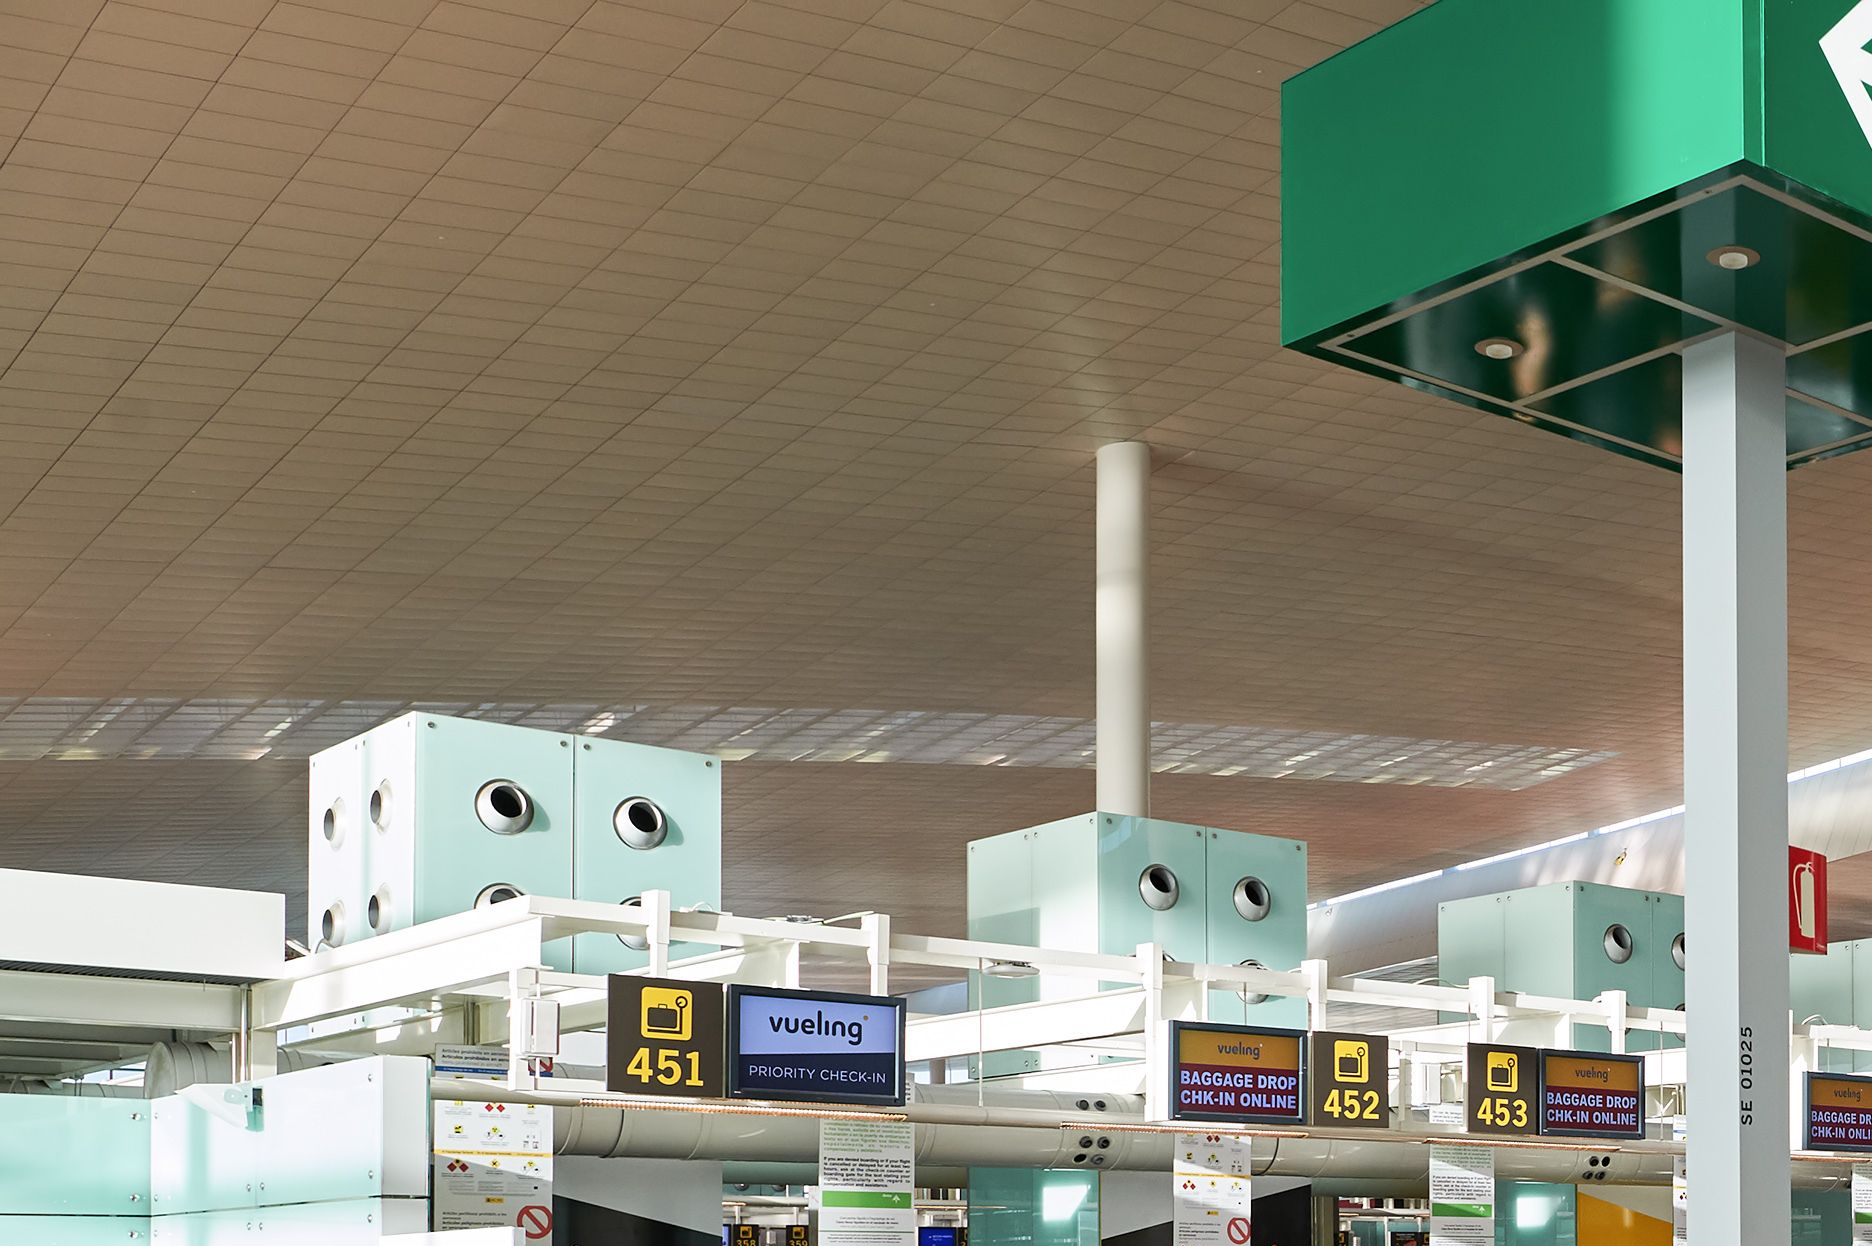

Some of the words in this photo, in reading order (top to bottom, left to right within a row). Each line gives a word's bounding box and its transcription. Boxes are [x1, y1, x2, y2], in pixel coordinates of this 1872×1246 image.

[769, 1010, 864, 1045] vueling
[1217, 1042, 1260, 1060] vueling
[1740, 1026, 1753, 1089] 01025
[626, 1047, 704, 1087] 451
[749, 1065, 816, 1081] PRIORITY
[820, 1069, 886, 1084] CHECK-IN
[1575, 1066, 1609, 1083] vueling
[1180, 1070, 1254, 1088] BAGGAGE
[1257, 1075, 1297, 1090] DROP
[1180, 1089, 1235, 1106] CHK-IN
[1239, 1093, 1297, 1109] ONLINE
[1546, 1092, 1603, 1107] BAGGAGE
[1606, 1096, 1637, 1109] DROP
[1834, 1087, 1861, 1102] vueling
[1323, 1089, 1380, 1120] 452
[1477, 1098, 1528, 1127] 453
[1740, 1100, 1753, 1125] SE
[1547, 1109, 1589, 1124] CHK-IN
[1592, 1112, 1637, 1125] ONLINE
[1811, 1110, 1857, 1124] BAGGAGE
[1811, 1126, 1846, 1139] CHK-IN
